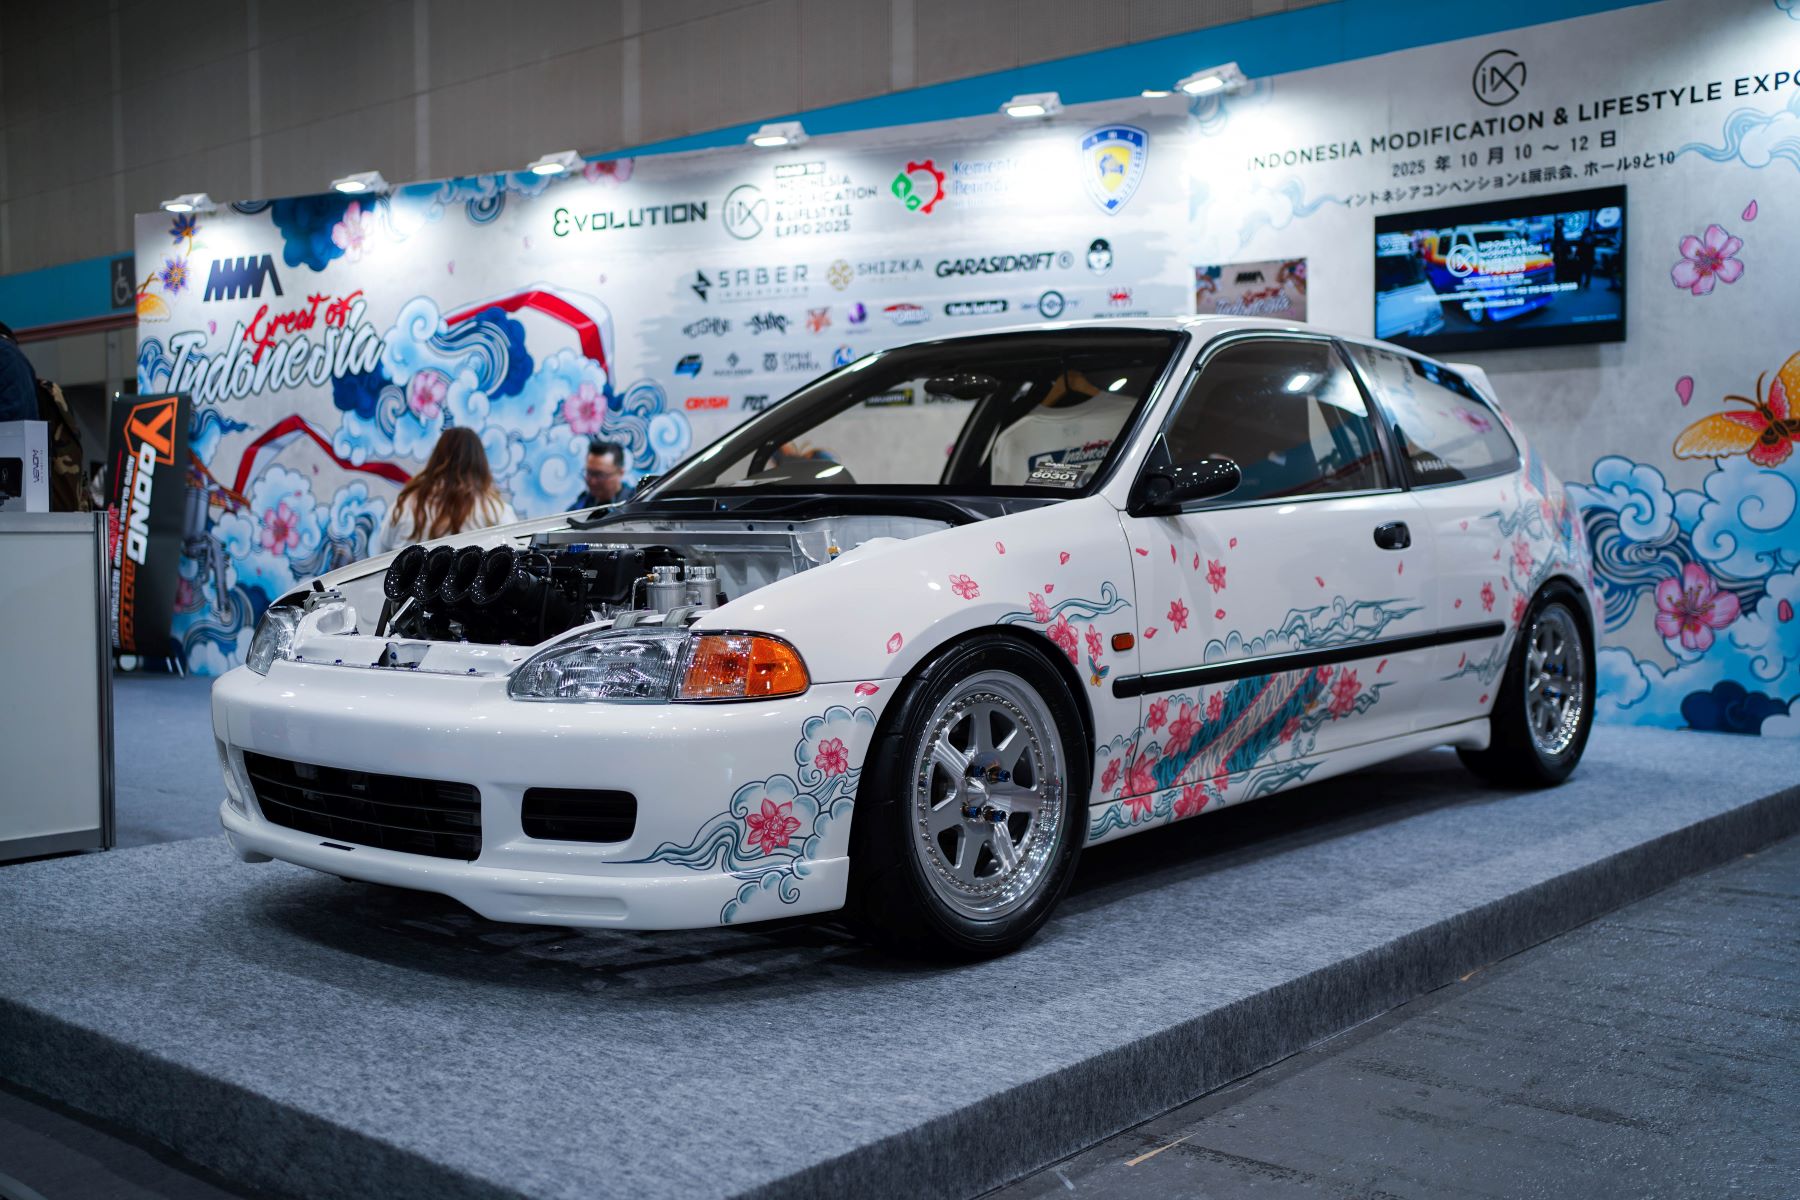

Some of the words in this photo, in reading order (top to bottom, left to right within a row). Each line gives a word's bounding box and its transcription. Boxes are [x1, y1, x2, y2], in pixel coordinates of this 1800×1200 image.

[1248, 141, 1362, 170] INDONESIA
[1371, 111, 1544, 153] MODIFICATION
[1553, 107, 1568, 126] &
[1578, 82, 1722, 122] LIFESTYLE
[1392, 160, 1425, 178] 2025
[1435, 154, 1452, 172] 年
[1461, 152, 1478, 168] 10
[1487, 147, 1504, 166] 月
[1515, 143, 1532, 161] 10
[1570, 135, 1589, 152] 12
[1600, 130, 1616, 148] 日
[718, 264, 809, 289] SABER
[857, 258, 924, 276] SHIZKA
[166, 299, 387, 406] Indonesia
[243, 292, 331, 365] Great
